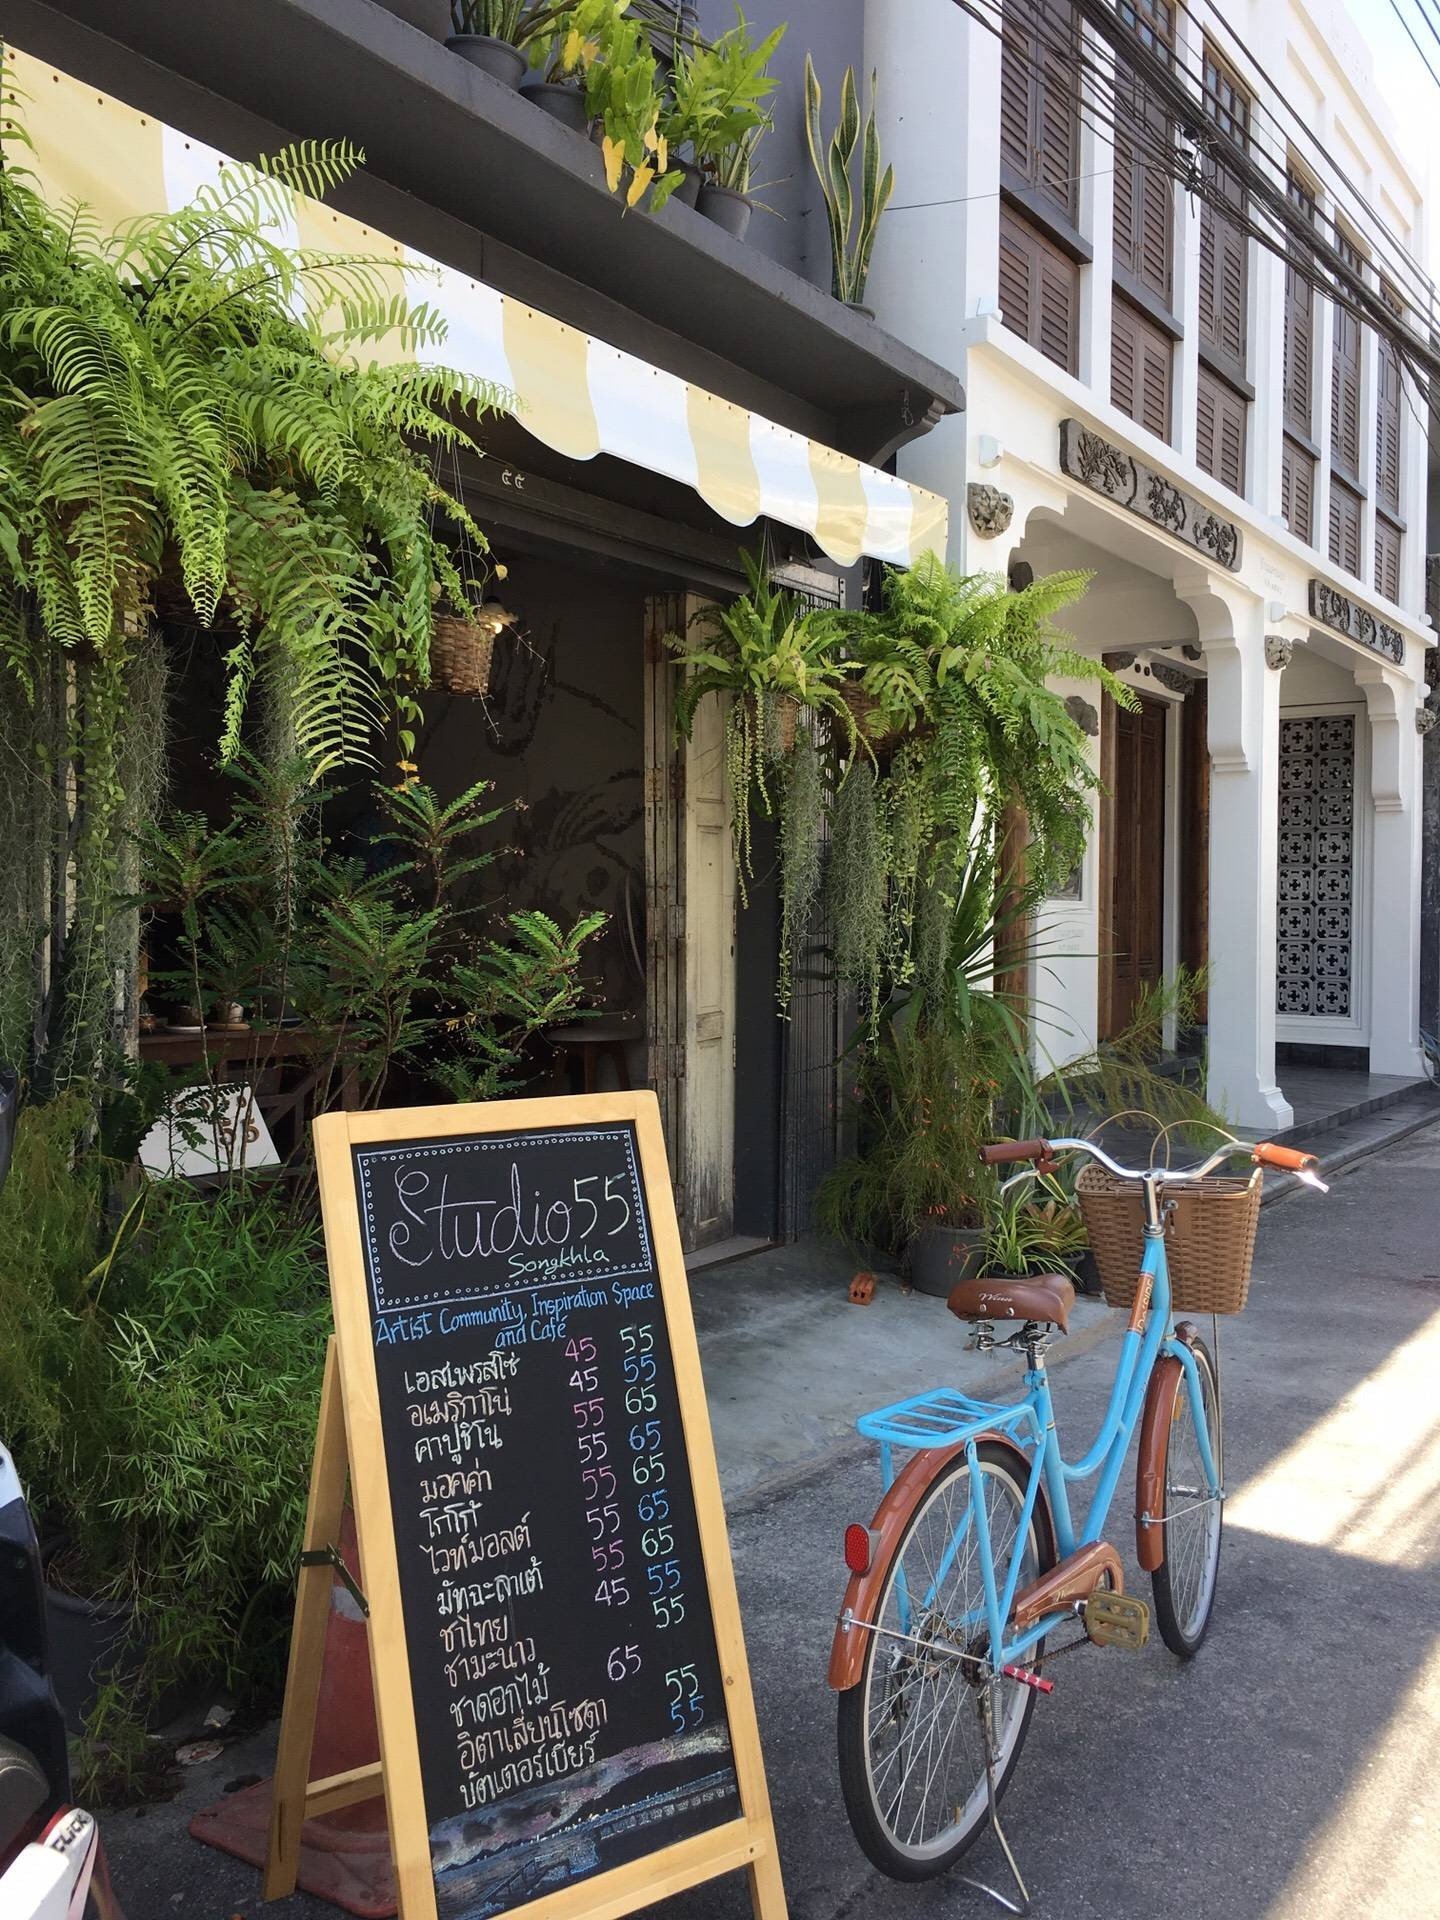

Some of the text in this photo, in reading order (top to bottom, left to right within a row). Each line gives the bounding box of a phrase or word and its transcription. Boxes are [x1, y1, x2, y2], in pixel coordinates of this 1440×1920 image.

[508, 1245, 609, 1278] Songkhla
[375, 1311, 432, 1346] Artist
[532, 1284, 607, 1318] Inspiration
[613, 1281, 654, 1308] Space
[495, 1324, 527, 1348] and
[565, 1337, 597, 1361] 45
[619, 1324, 653, 1353] 55
[569, 1367, 598, 1392] 45
[624, 1354, 656, 1383] 55
[573, 1398, 604, 1428] 55
[625, 1384, 657, 1414] 65
[578, 1432, 607, 1463] 55
[629, 1420, 661, 1450] 65
[582, 1465, 616, 1499] 55
[632, 1452, 665, 1484] 65
[586, 1503, 620, 1540] 55
[638, 1489, 669, 1521] 65
[592, 1539, 624, 1572] 55
[642, 1525, 673, 1557] 65
[440, 1560, 681, 1652] ชาไทย 45 55
[653, 1593, 686, 1628] 55
[607, 1645, 642, 1681] 65
[666, 1663, 699, 1704] 55
[670, 1695, 705, 1734] 55
